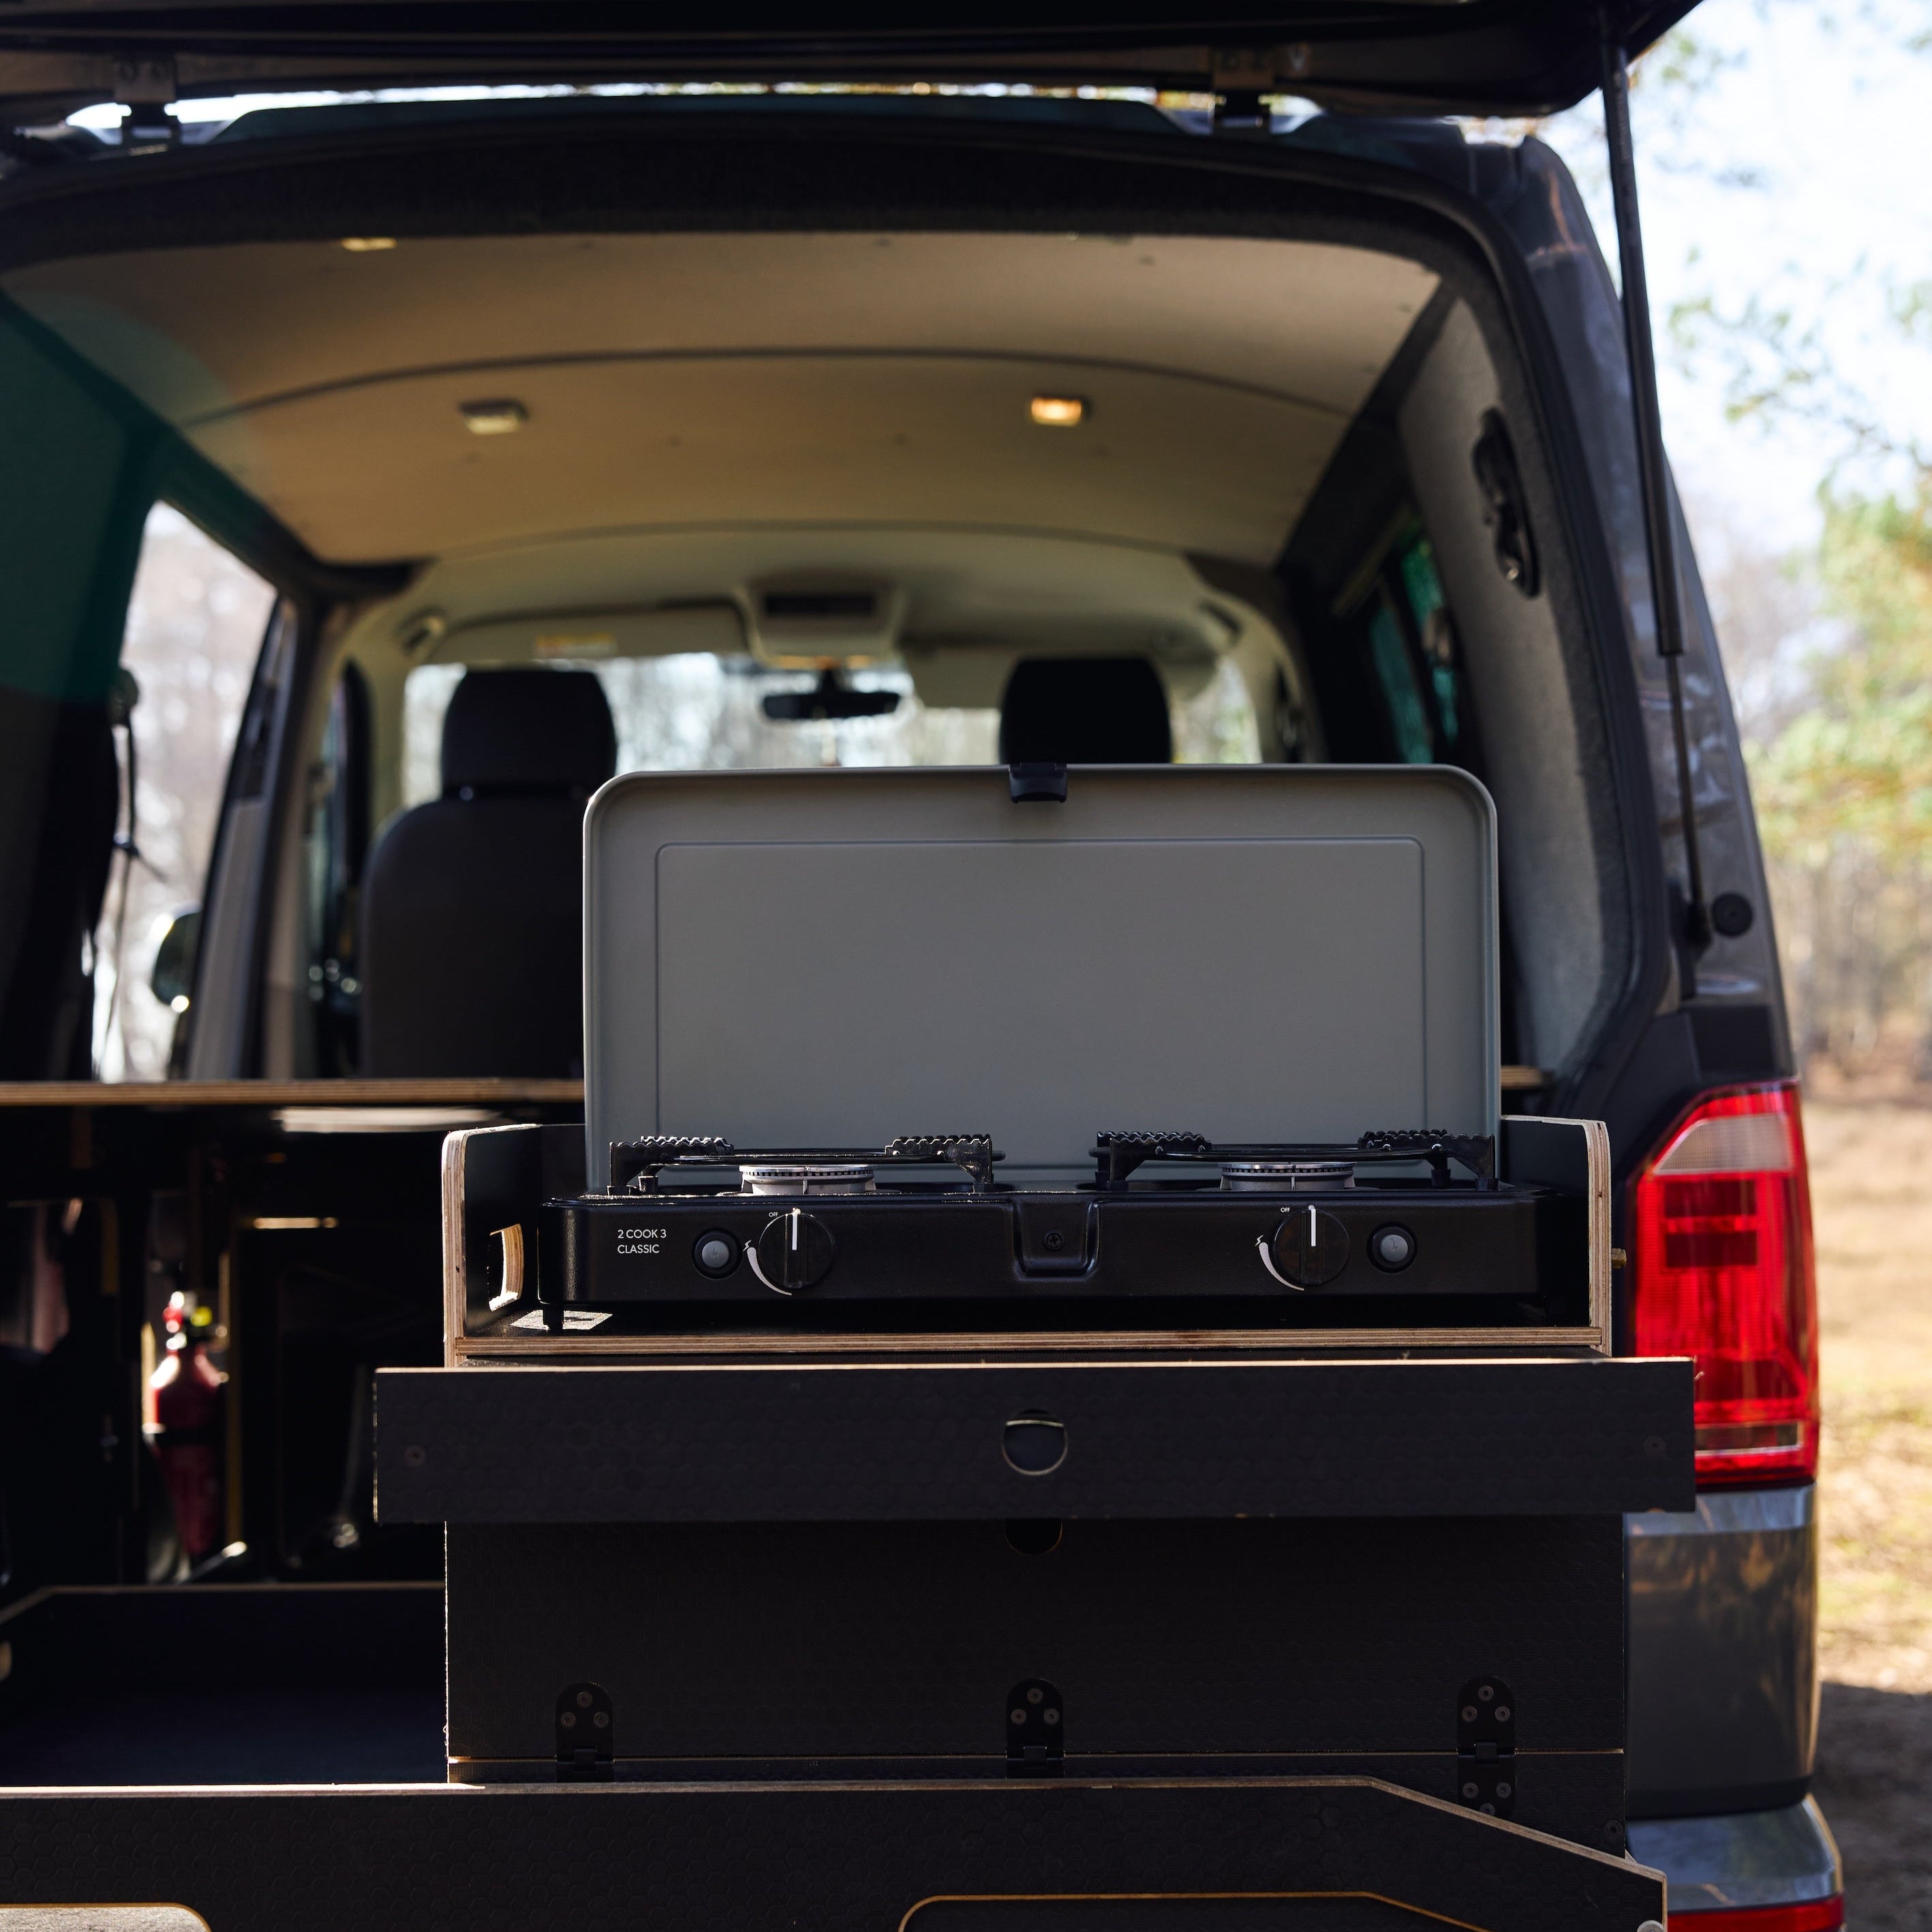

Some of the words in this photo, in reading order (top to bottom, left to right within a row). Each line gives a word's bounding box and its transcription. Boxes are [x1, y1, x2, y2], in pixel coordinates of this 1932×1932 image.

[617, 1229, 624, 1239] 2
[626, 1229, 658, 1239] COOK
[660, 1229, 667, 1239] 3
[617, 1244, 660, 1254] CLASSIC
